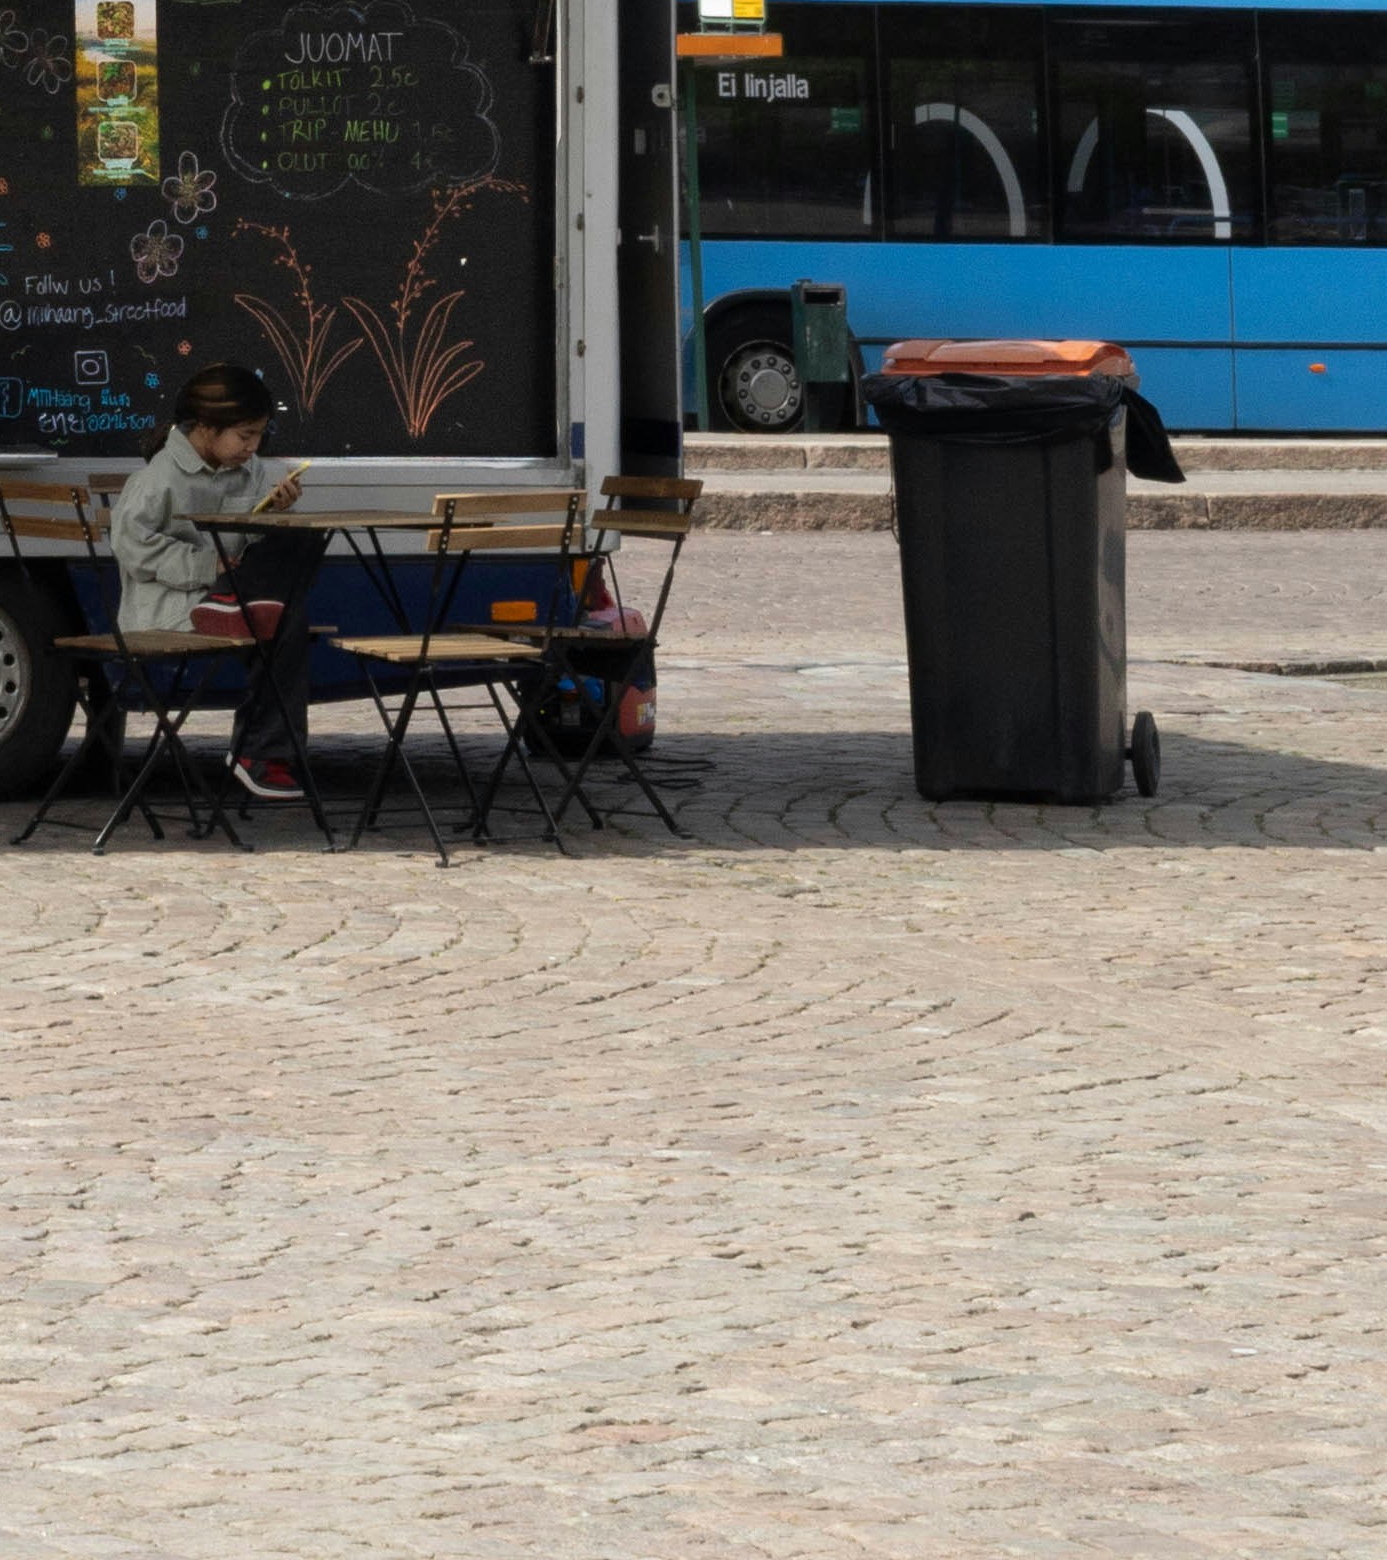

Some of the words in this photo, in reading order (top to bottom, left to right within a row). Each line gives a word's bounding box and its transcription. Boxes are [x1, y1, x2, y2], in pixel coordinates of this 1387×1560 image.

[284, 31, 404, 64] JUOMAT
[717, 72, 737, 98] Ei
[744, 72, 810, 103] linjalla
